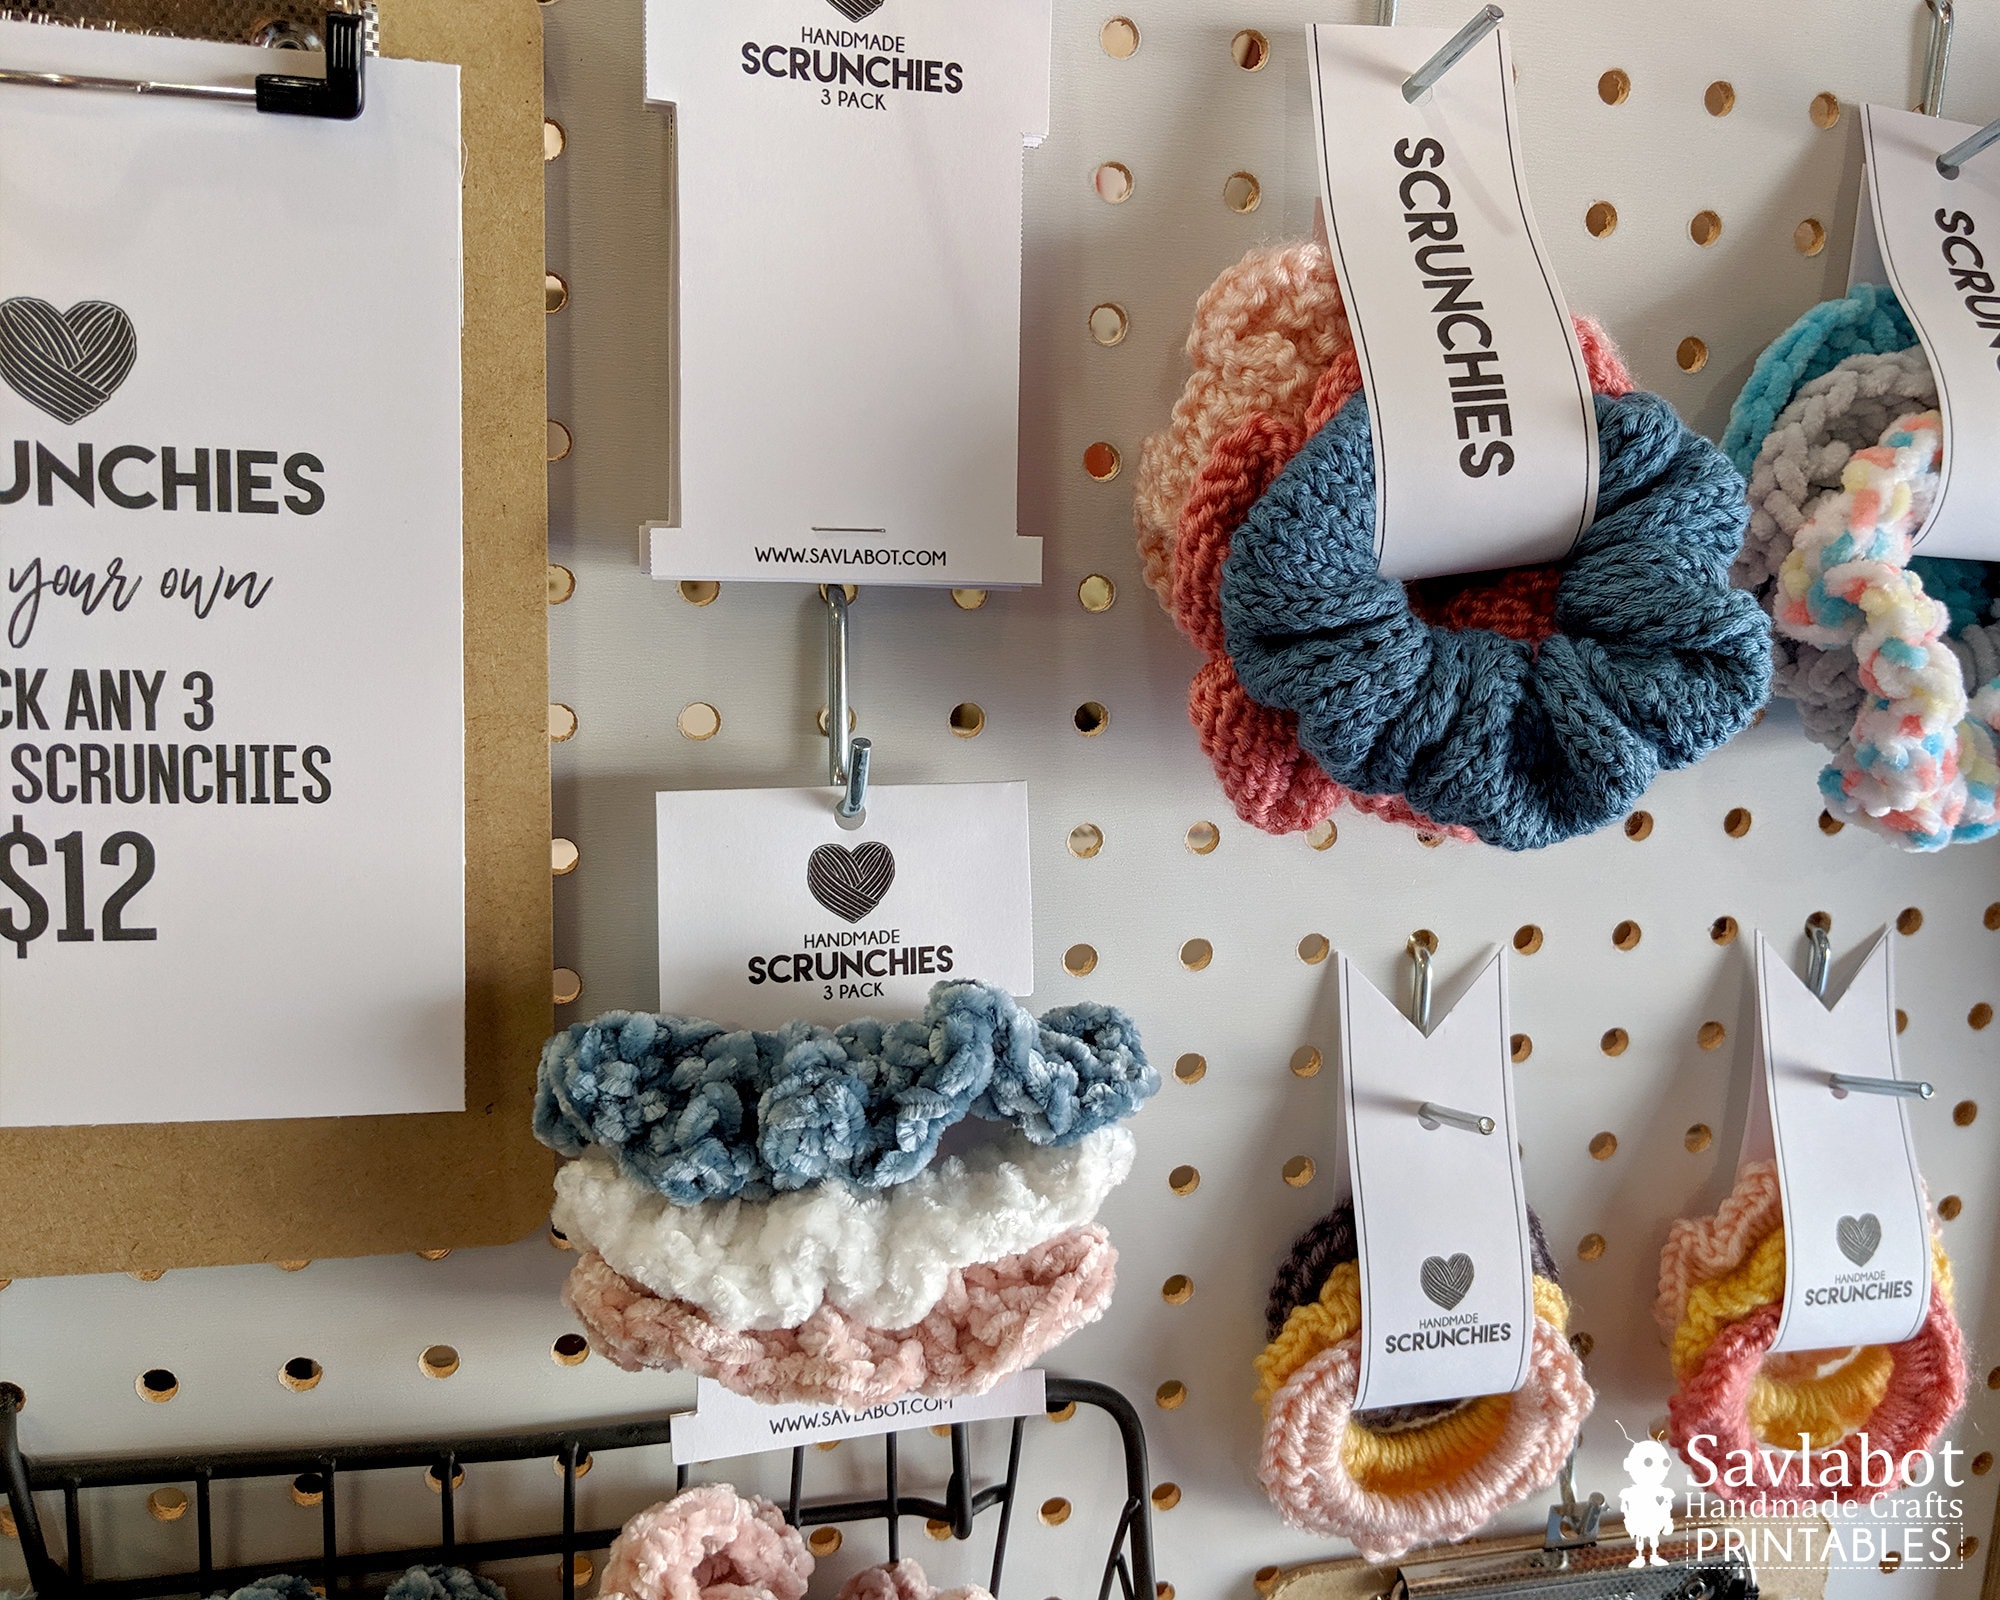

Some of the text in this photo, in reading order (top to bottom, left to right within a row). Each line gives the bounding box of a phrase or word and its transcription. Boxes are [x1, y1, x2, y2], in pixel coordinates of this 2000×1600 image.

[801, 26, 905, 53] HANDMADE
[741, 41, 964, 94] SCRUNCHIES
[820, 88, 886, 111] 3 PACK
[1393, 137, 1515, 478] SCRUNCHIES
[755, 546, 946, 567] WWW.SAVLABOT.COM
[8, 557, 273, 649] your own
[65, 669, 167, 731] ANY
[183, 670, 214, 732] 3
[10, 743, 332, 804] SCRUNCHIES
[0, 814, 157, 959] $12
[804, 929, 900, 949] HANDMADE
[748, 945, 953, 985] SCRUNCHIES
[823, 982, 885, 1001] 3 PACK
[1834, 1270, 1886, 1284] HANDMADE
[1804, 1280, 1913, 1306] SCRUNCHIES
[1419, 1313, 1479, 1329] HANDMADE
[1385, 1323, 1512, 1354] SCRUNCHIES
